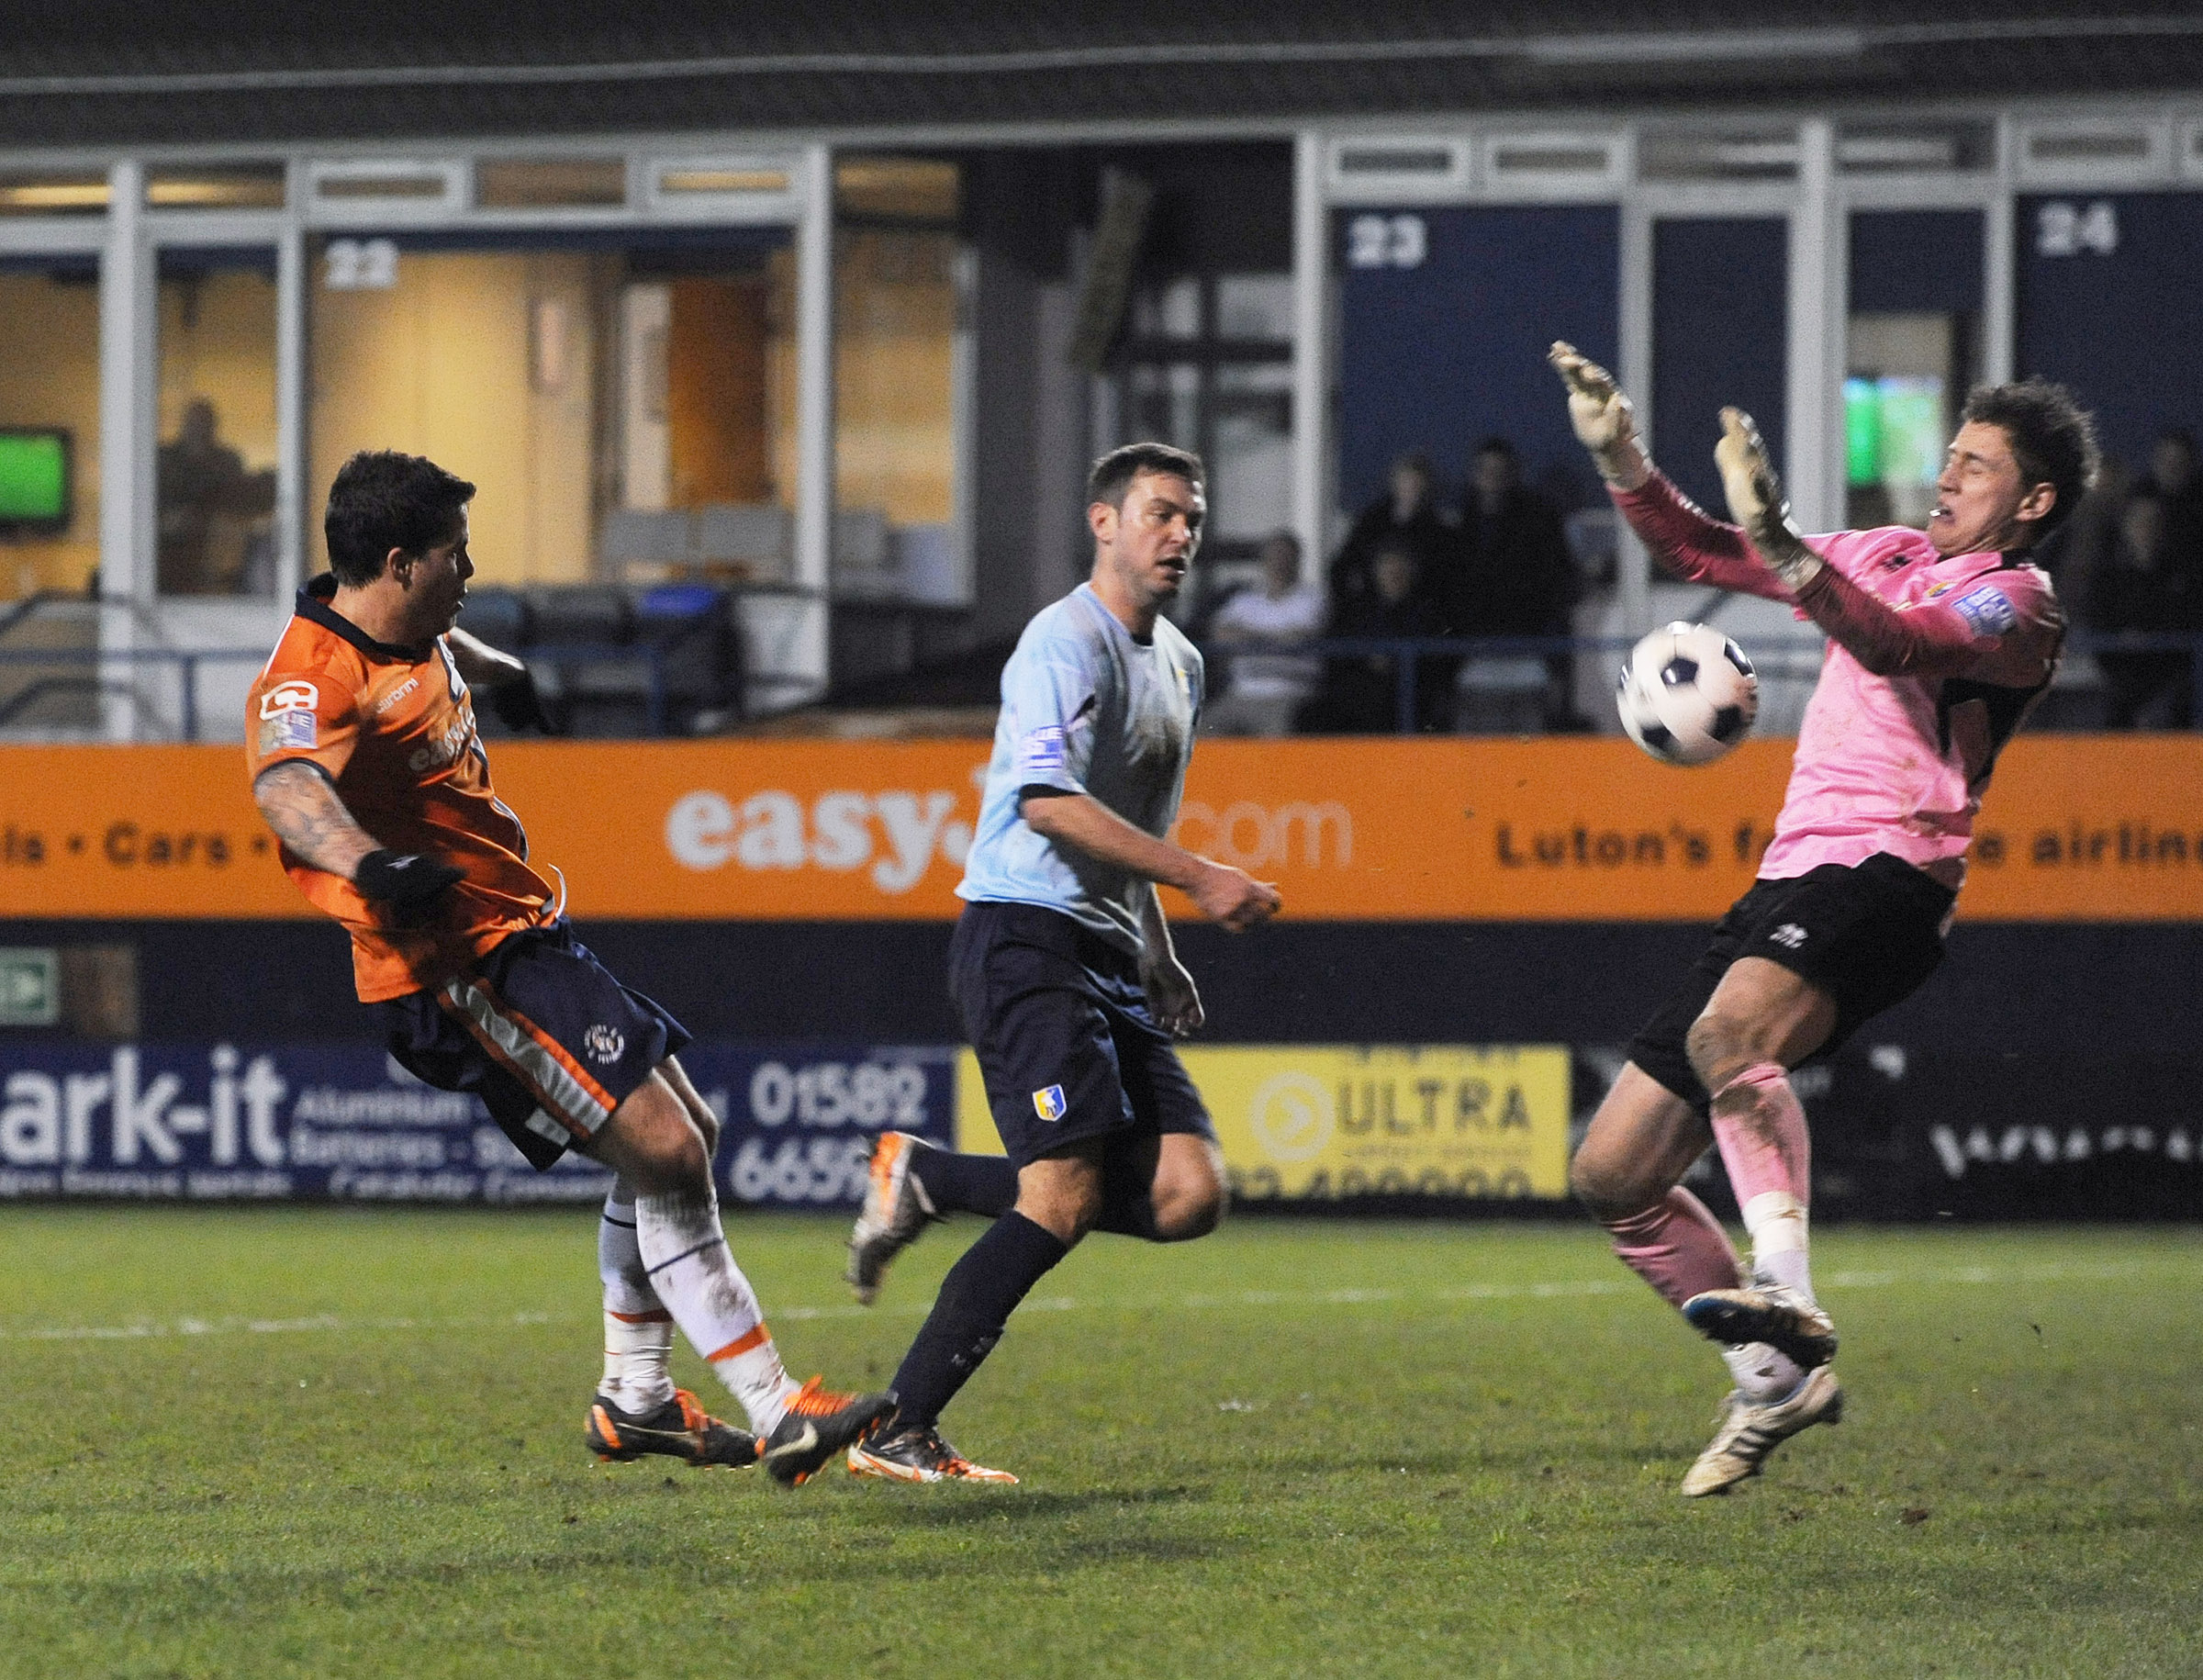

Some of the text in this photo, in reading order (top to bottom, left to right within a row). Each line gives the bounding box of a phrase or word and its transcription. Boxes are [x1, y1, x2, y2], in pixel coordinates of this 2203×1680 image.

[1348, 215, 1427, 268] 23
[2036, 201, 2117, 256] 24
[325, 238, 399, 289] 22
[103, 820, 230, 869] Cars
[1495, 820, 1710, 867] Luton's
[0, 1045, 287, 1166] ark-it
[749, 1061, 930, 1127] 01582
[1337, 1075, 1532, 1137] ULTRA
[731, 1137, 872, 1202] 6659
